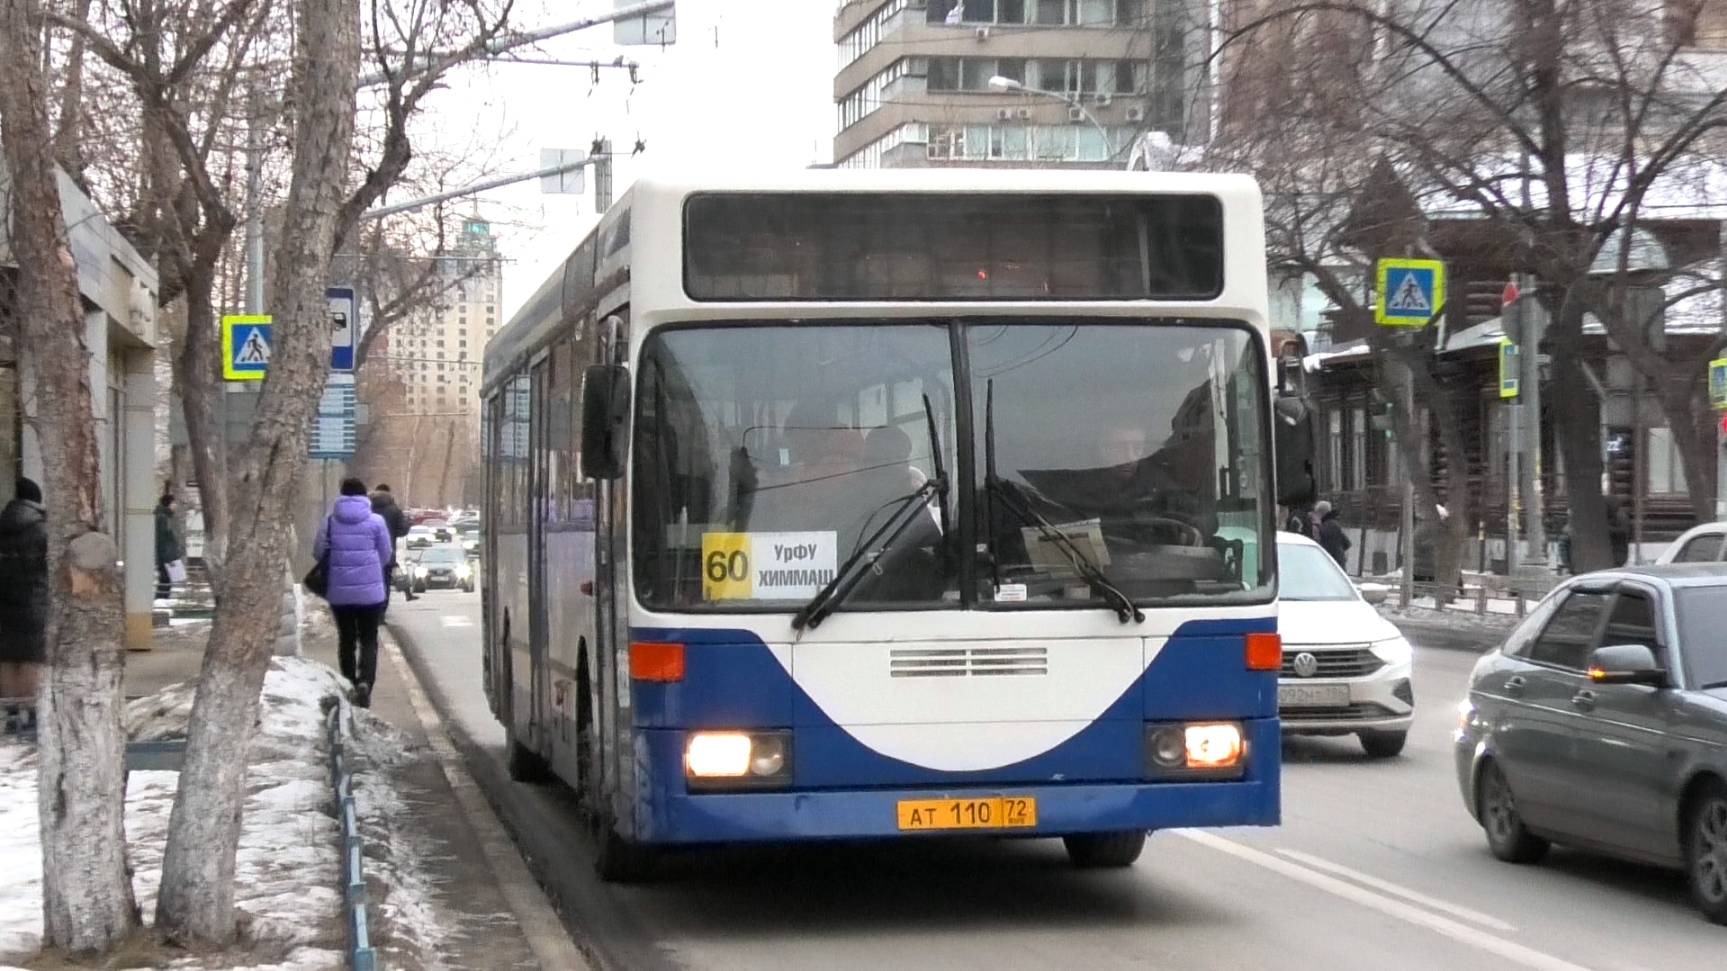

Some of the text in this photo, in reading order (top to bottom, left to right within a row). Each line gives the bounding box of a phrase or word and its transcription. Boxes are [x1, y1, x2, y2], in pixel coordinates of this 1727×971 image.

[774, 543, 817, 563] УрФУ
[706, 549, 749, 583] 60
[758, 569, 834, 587] ХИММАШ
[910, 800, 1027, 826] АТ 110 72
